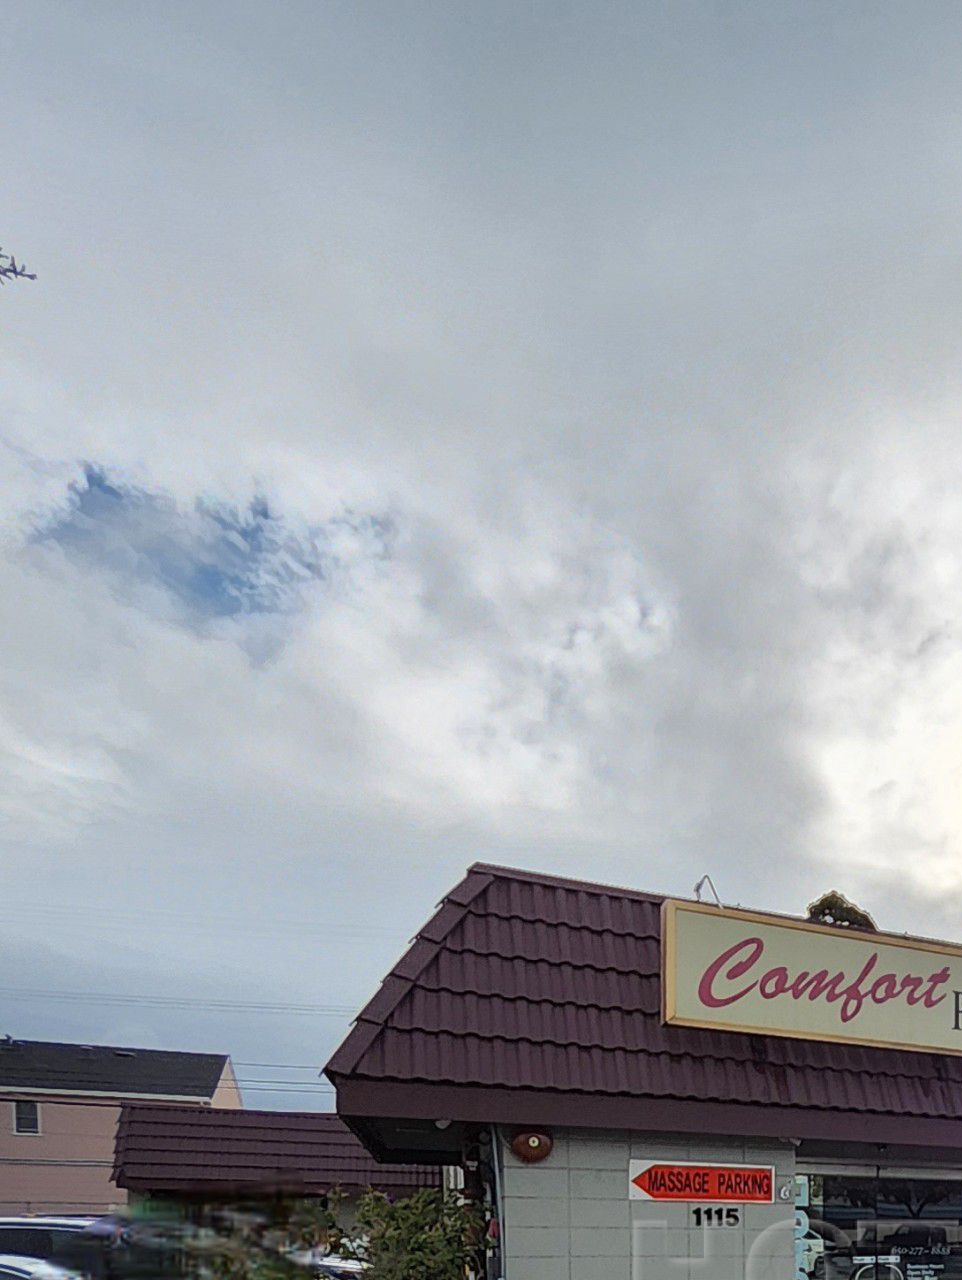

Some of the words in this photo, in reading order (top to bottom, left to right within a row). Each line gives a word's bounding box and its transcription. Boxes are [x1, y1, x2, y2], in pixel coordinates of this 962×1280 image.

[698, 937, 950, 1022] Comfort
[648, 1169, 709, 1193] MASSAGE
[718, 1173, 770, 1195] PARKING
[692, 1207, 740, 1228] 1115
